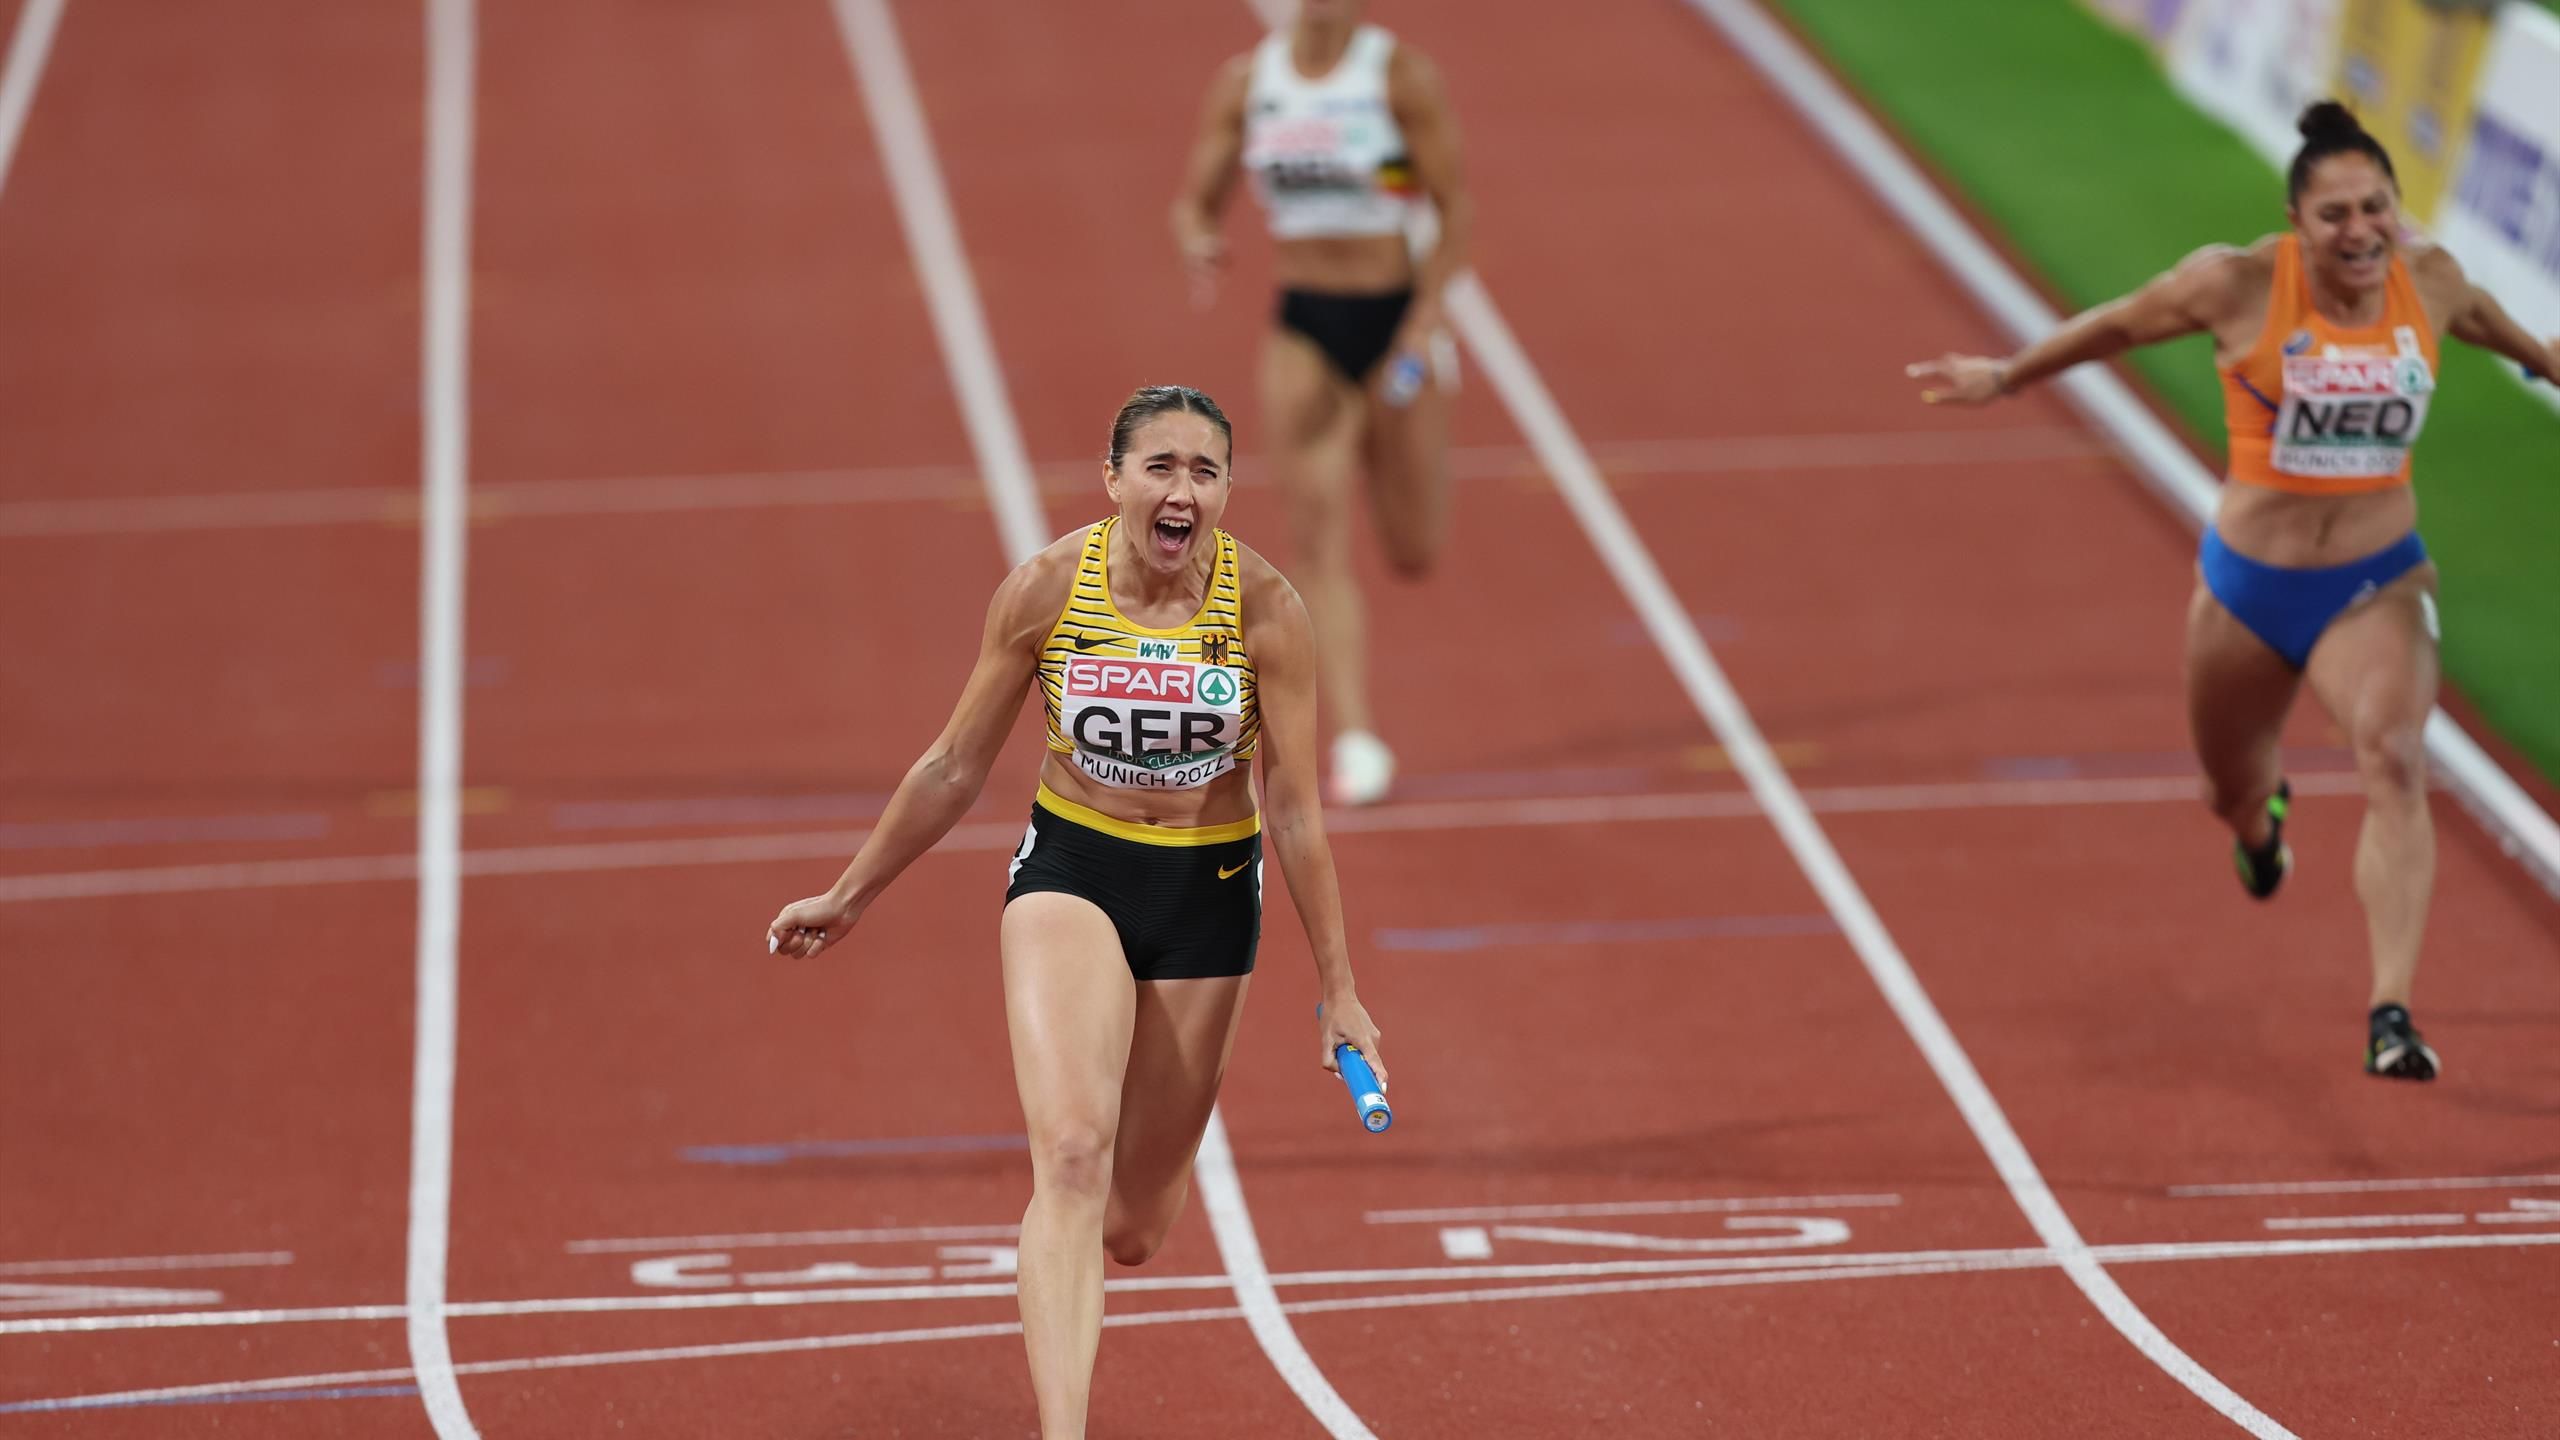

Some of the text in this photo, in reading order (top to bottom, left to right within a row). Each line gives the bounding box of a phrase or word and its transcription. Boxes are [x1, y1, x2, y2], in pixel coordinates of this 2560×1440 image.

[2291, 398, 2413, 439] NED
[1071, 664, 1191, 698] SPAR
[1073, 706, 1227, 758] GER
[1080, 754, 1225, 787] MUNICH 2022
[1148, 752, 1194, 769] CLEAN
